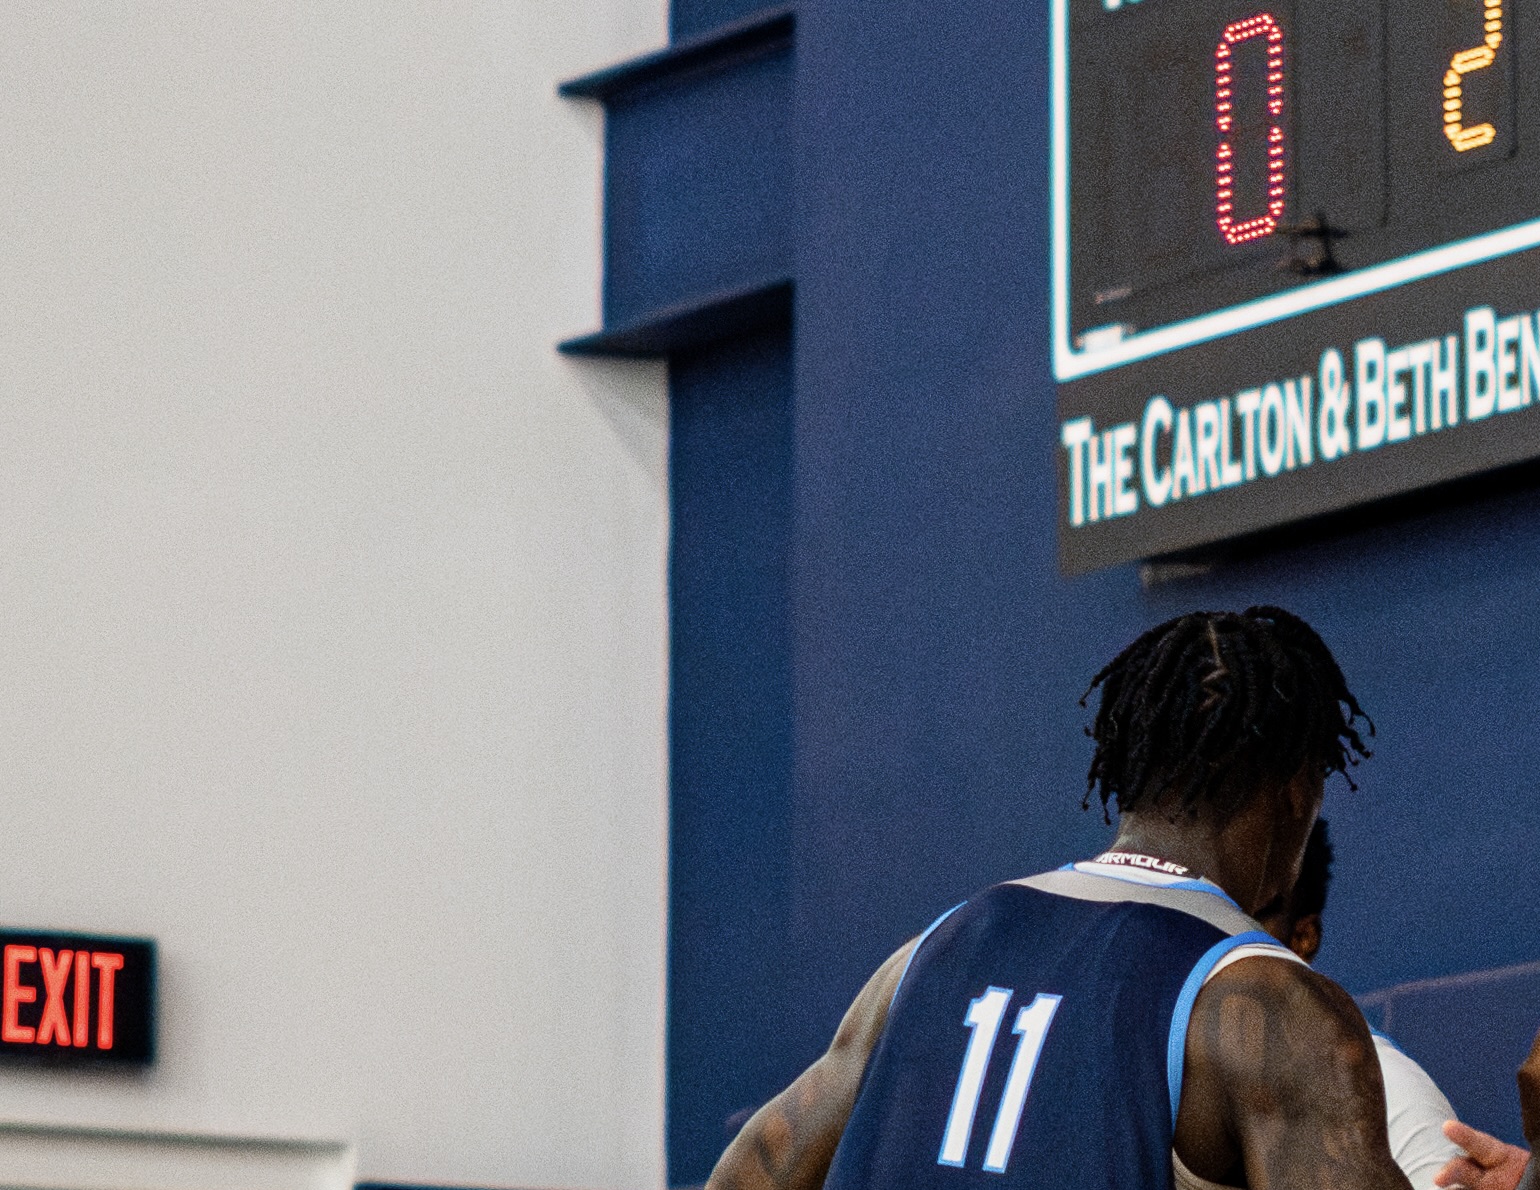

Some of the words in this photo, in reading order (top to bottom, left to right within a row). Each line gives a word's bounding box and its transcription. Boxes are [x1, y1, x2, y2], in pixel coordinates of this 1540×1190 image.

[1215, 13, 1284, 243] 0
[1061, 416, 1138, 527] THE
[1141, 376, 1314, 507] CARLTON
[1318, 348, 1350, 461] &
[1354, 336, 1459, 452] BETH
[1096, 852, 1189, 875] ARMOUR
[2, 944, 124, 1050] EXIT
[937, 985, 1063, 1174] 11
